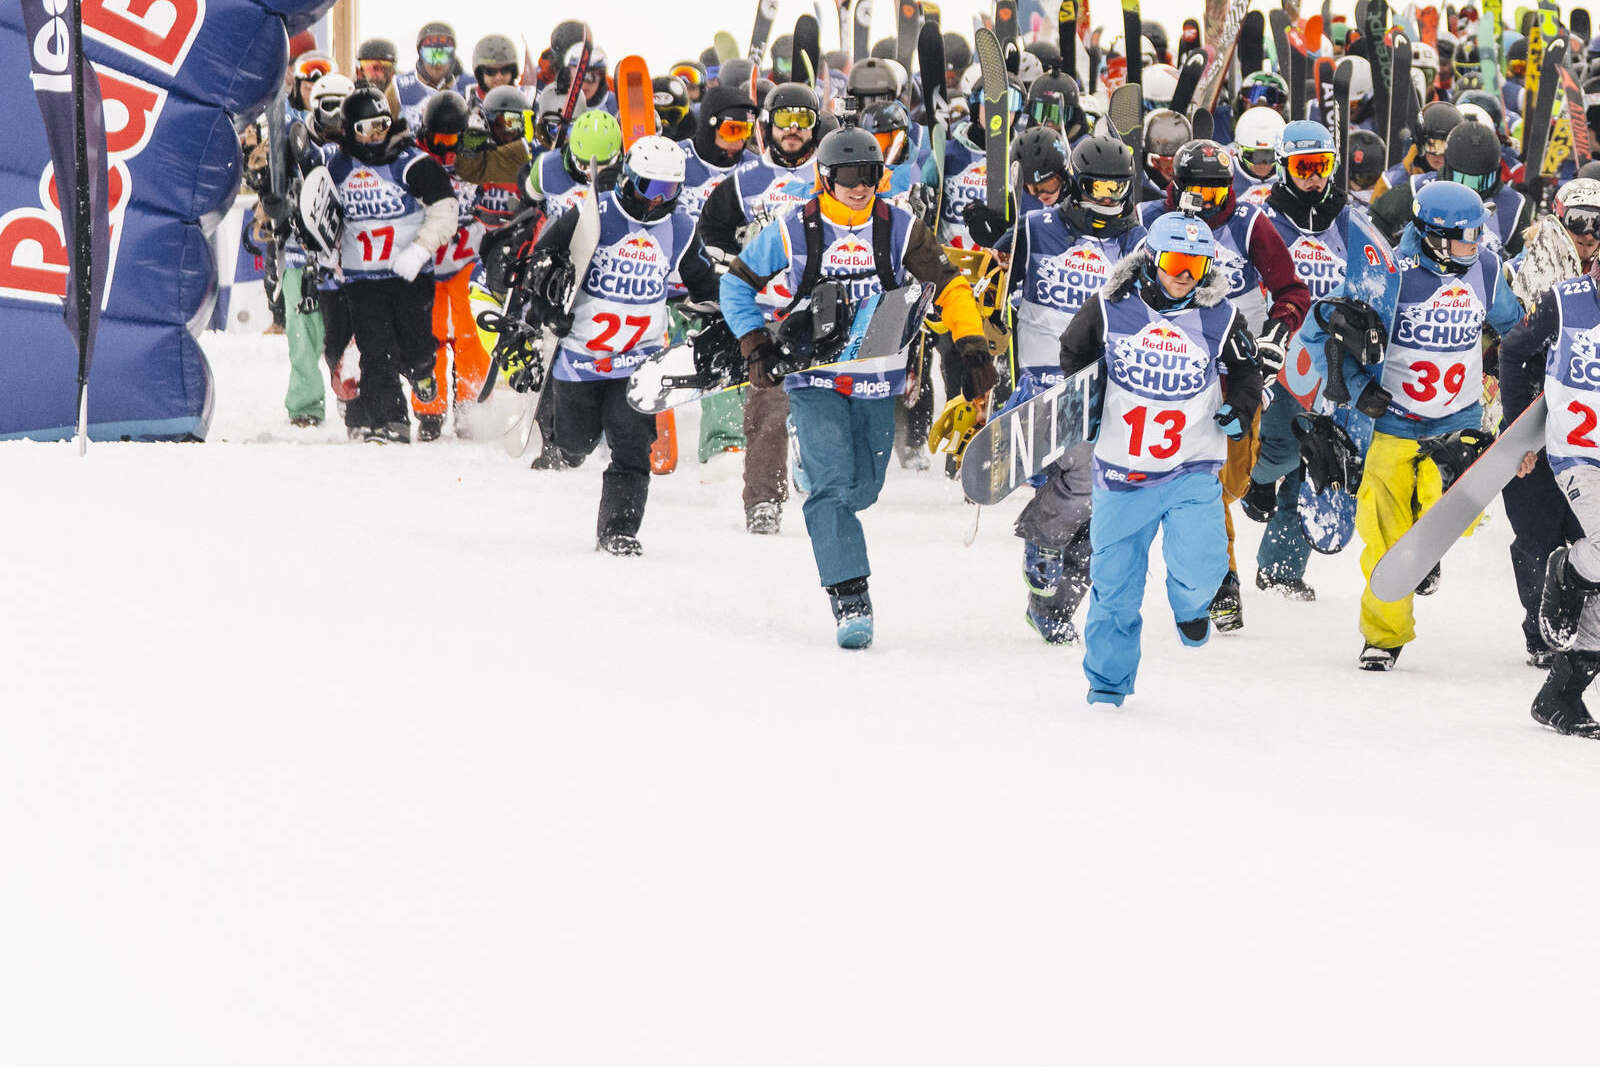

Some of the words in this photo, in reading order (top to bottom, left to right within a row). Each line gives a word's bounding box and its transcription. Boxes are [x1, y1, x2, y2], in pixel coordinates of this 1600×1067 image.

[345, 202, 403, 215] CHUSS
[356, 226, 395, 261] 17
[618, 248, 638, 259] Red
[639, 251, 657, 262] Bull
[830, 254, 851, 265] Red
[852, 254, 873, 265] Bull
[1294, 250, 1313, 260] Red
[611, 258, 657, 277] TOUT
[1065, 259, 1085, 271] Red
[1086, 263, 1105, 274] Bull
[1563, 282, 1592, 295] 223
[1452, 299, 1471, 308] Bull
[1425, 308, 1472, 323] TOUT
[585, 312, 652, 354] 27
[1142, 338, 1163, 350] Red
[1165, 342, 1187, 354] Bull
[1134, 347, 1190, 371] TOUT
[1115, 360, 1205, 393] SCHUSS
[1402, 360, 1466, 406] 39
[809, 375, 833, 389] les
[854, 380, 890, 396] alpes
[1122, 405, 1187, 459] 13
